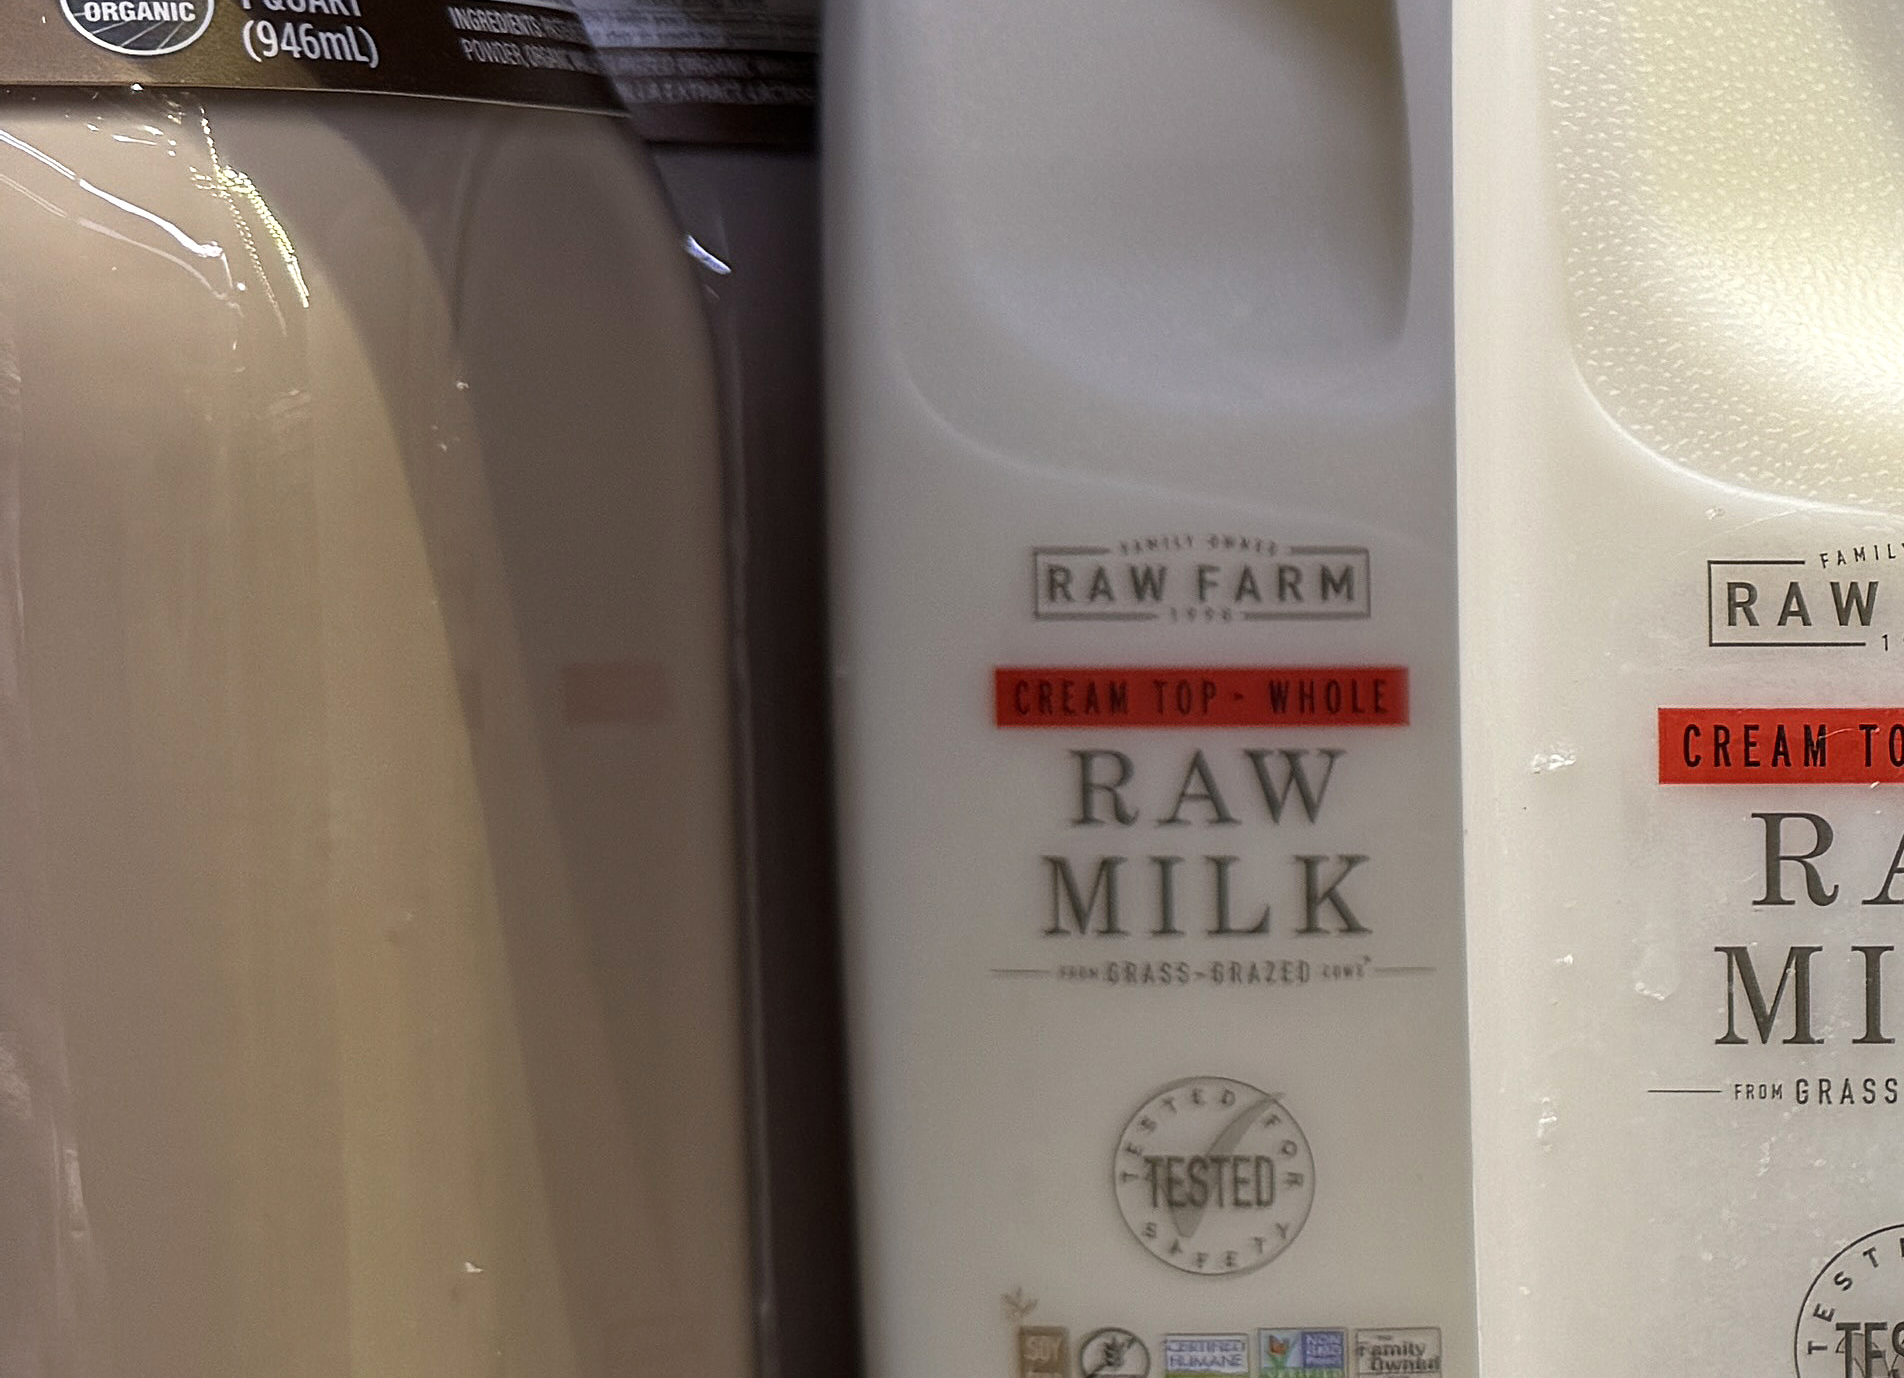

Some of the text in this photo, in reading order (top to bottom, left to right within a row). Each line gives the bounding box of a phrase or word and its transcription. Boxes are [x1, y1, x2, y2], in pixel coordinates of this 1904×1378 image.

[84, 0, 195, 22] ORGANIC
[242, 19, 380, 68] (946mL)
[1047, 564, 1355, 603] RAW FARM
[1726, 580, 1878, 627] RAW
[1014, 679, 1388, 717] CREAM TOP WHOLE
[1684, 724, 1827, 768] CREAM
[1070, 749, 1346, 828] RAW
[1042, 854, 1372, 938] MILK
[1108, 960, 1311, 985] GRASS-GRAZED
[1143, 1156, 1275, 1209] TESTED
